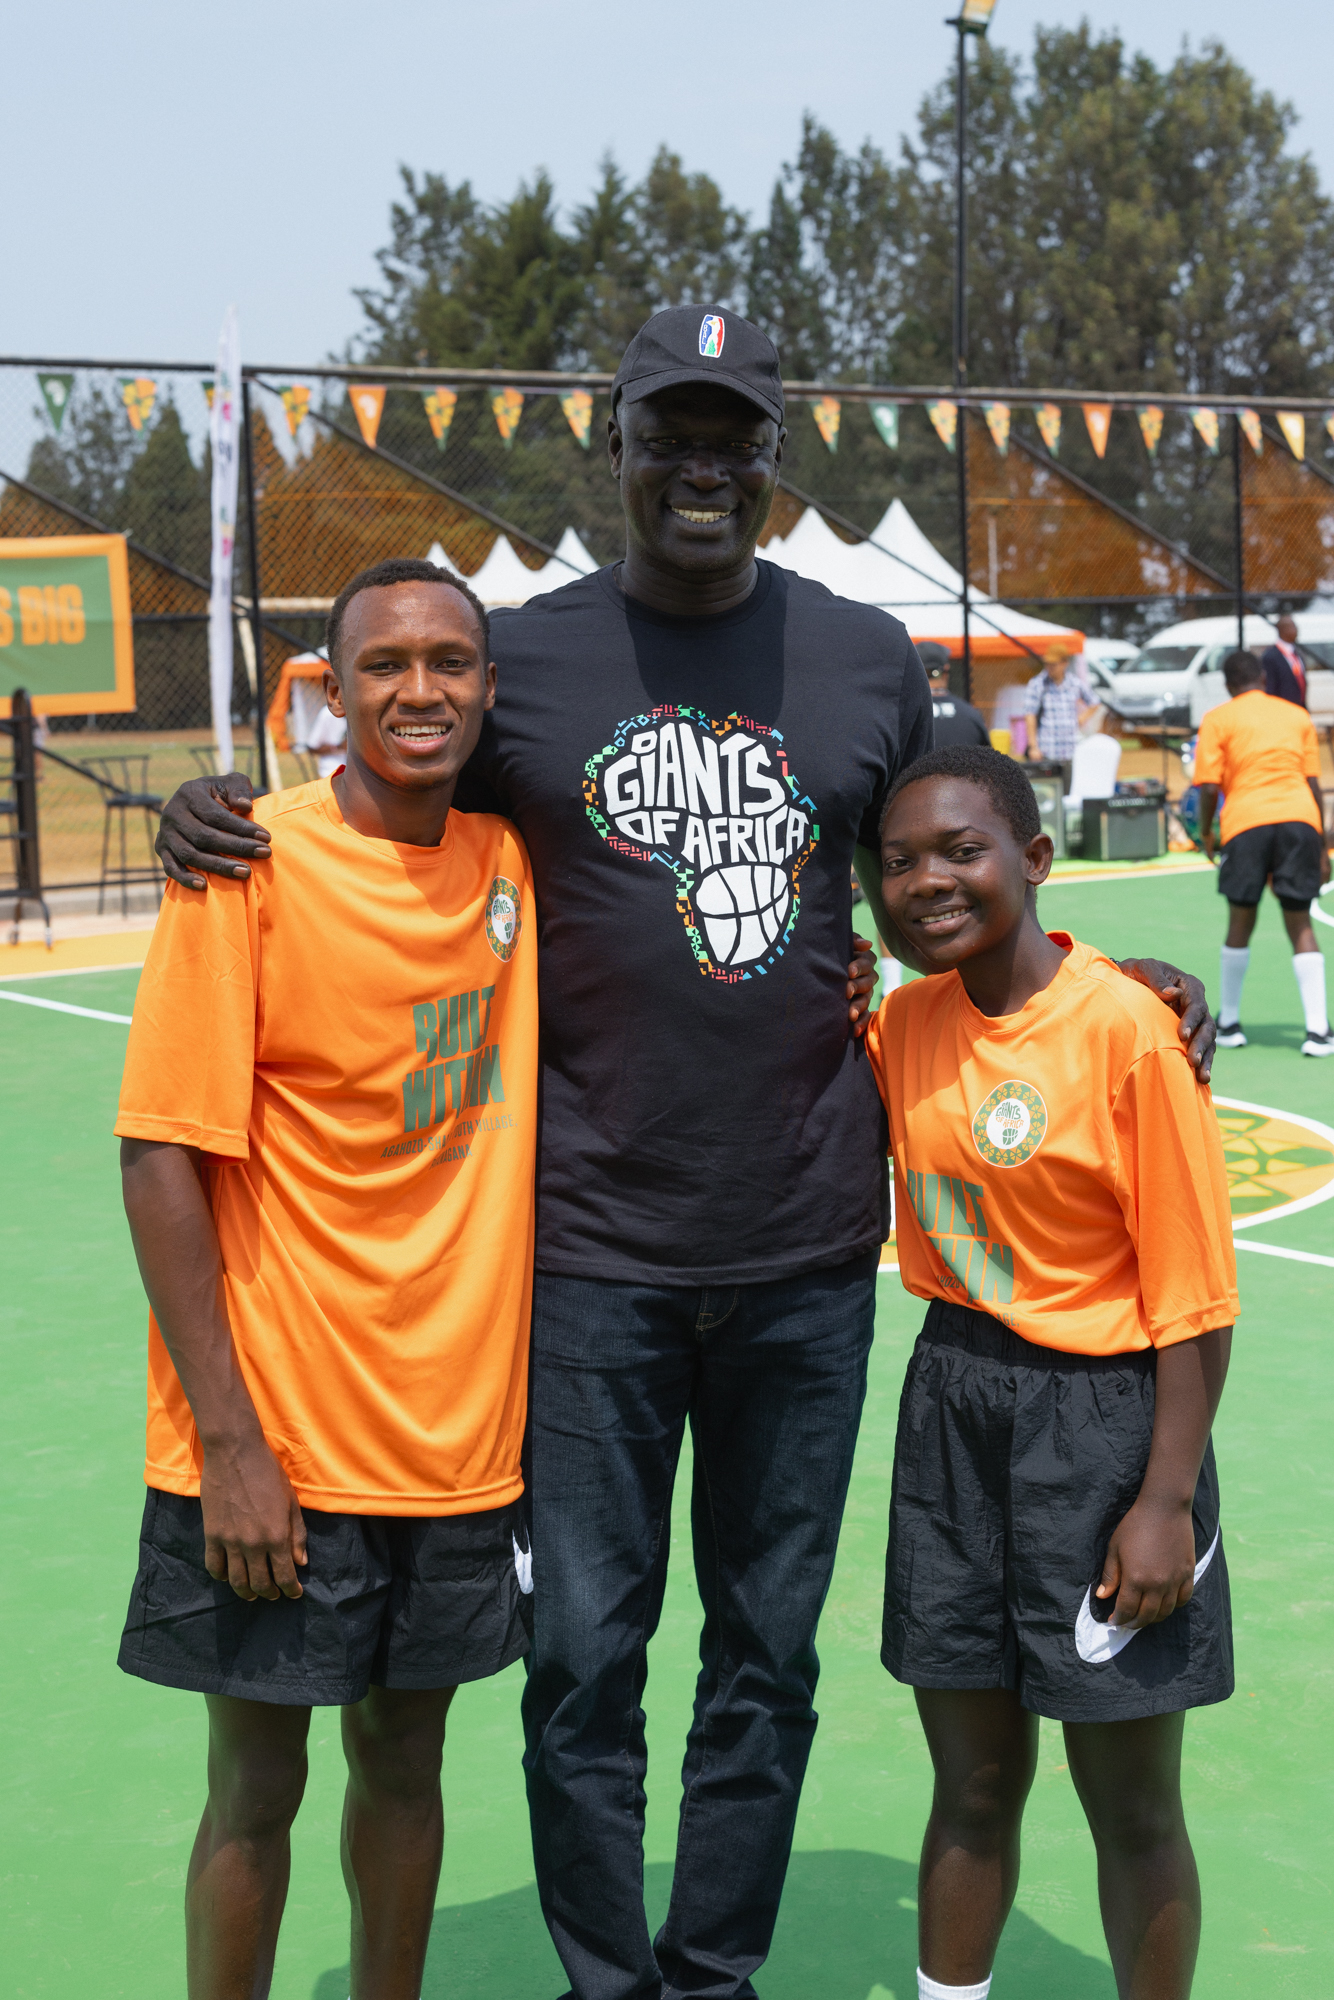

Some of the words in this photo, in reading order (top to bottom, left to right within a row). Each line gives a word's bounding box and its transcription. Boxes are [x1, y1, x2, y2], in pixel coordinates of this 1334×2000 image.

[17, 583, 87, 646] BIG
[614, 810, 681, 846] OF
[681, 804, 810, 874] AFRICA
[412, 983, 496, 1064] BUILT
